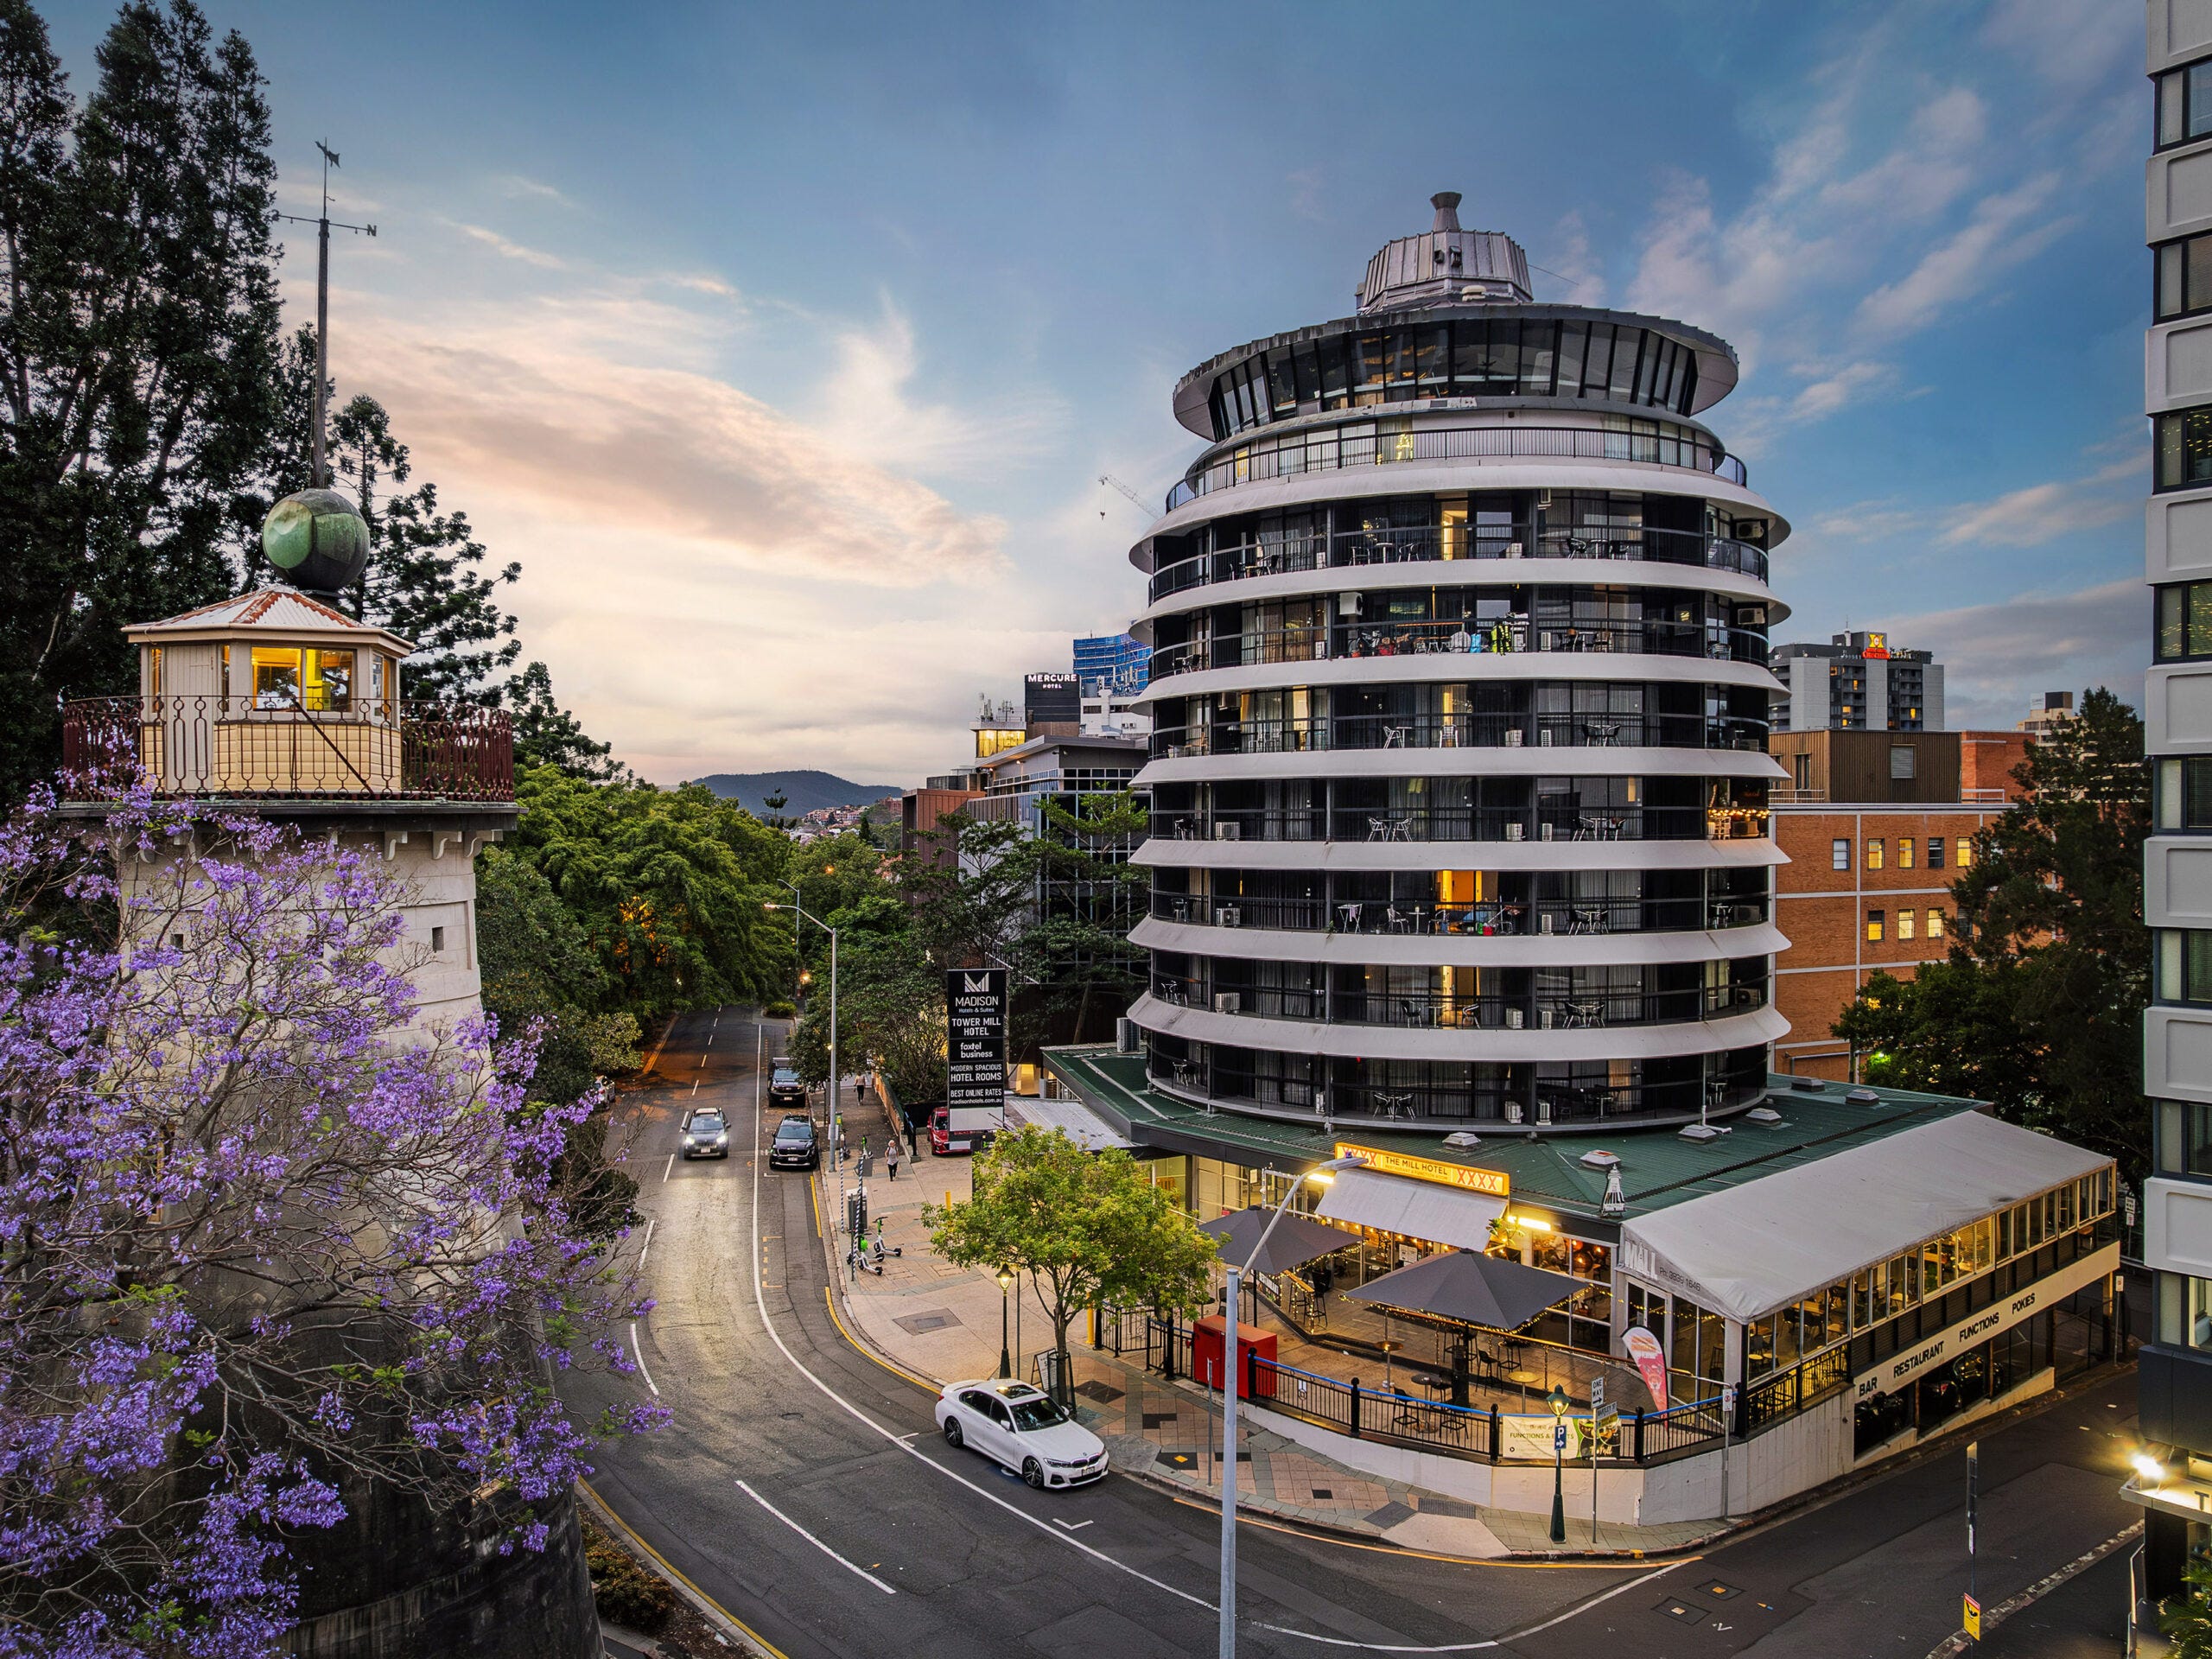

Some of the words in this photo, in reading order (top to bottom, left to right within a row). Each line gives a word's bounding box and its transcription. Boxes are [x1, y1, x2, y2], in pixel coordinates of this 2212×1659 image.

[955, 996, 999, 1007] MADISON
[951, 1018, 981, 1027] TOWER
[982, 1017, 1001, 1026] MILL
[950, 1073, 974, 1082] HOTEL
[976, 1072, 1002, 1081] ROOMS
[1385, 1156, 1399, 1166] THE
[1402, 1160, 1420, 1170] MILL
[1421, 1164, 1447, 1175] HOTEL
[1457, 1168, 1497, 1191] XXXX
[1605, 1192, 1624, 1205] MILL
[1859, 1376, 1878, 1397] BAR
[1893, 1340, 1944, 1378] RESTAURANT
[1959, 1312, 1999, 1342] FUNCTIONS
[2012, 1292, 2036, 1314] POKIES
[1592, 1379, 1603, 1389] ONE
[1592, 1389, 1603, 1398] WAY
[1557, 1427, 1565, 1439] P
